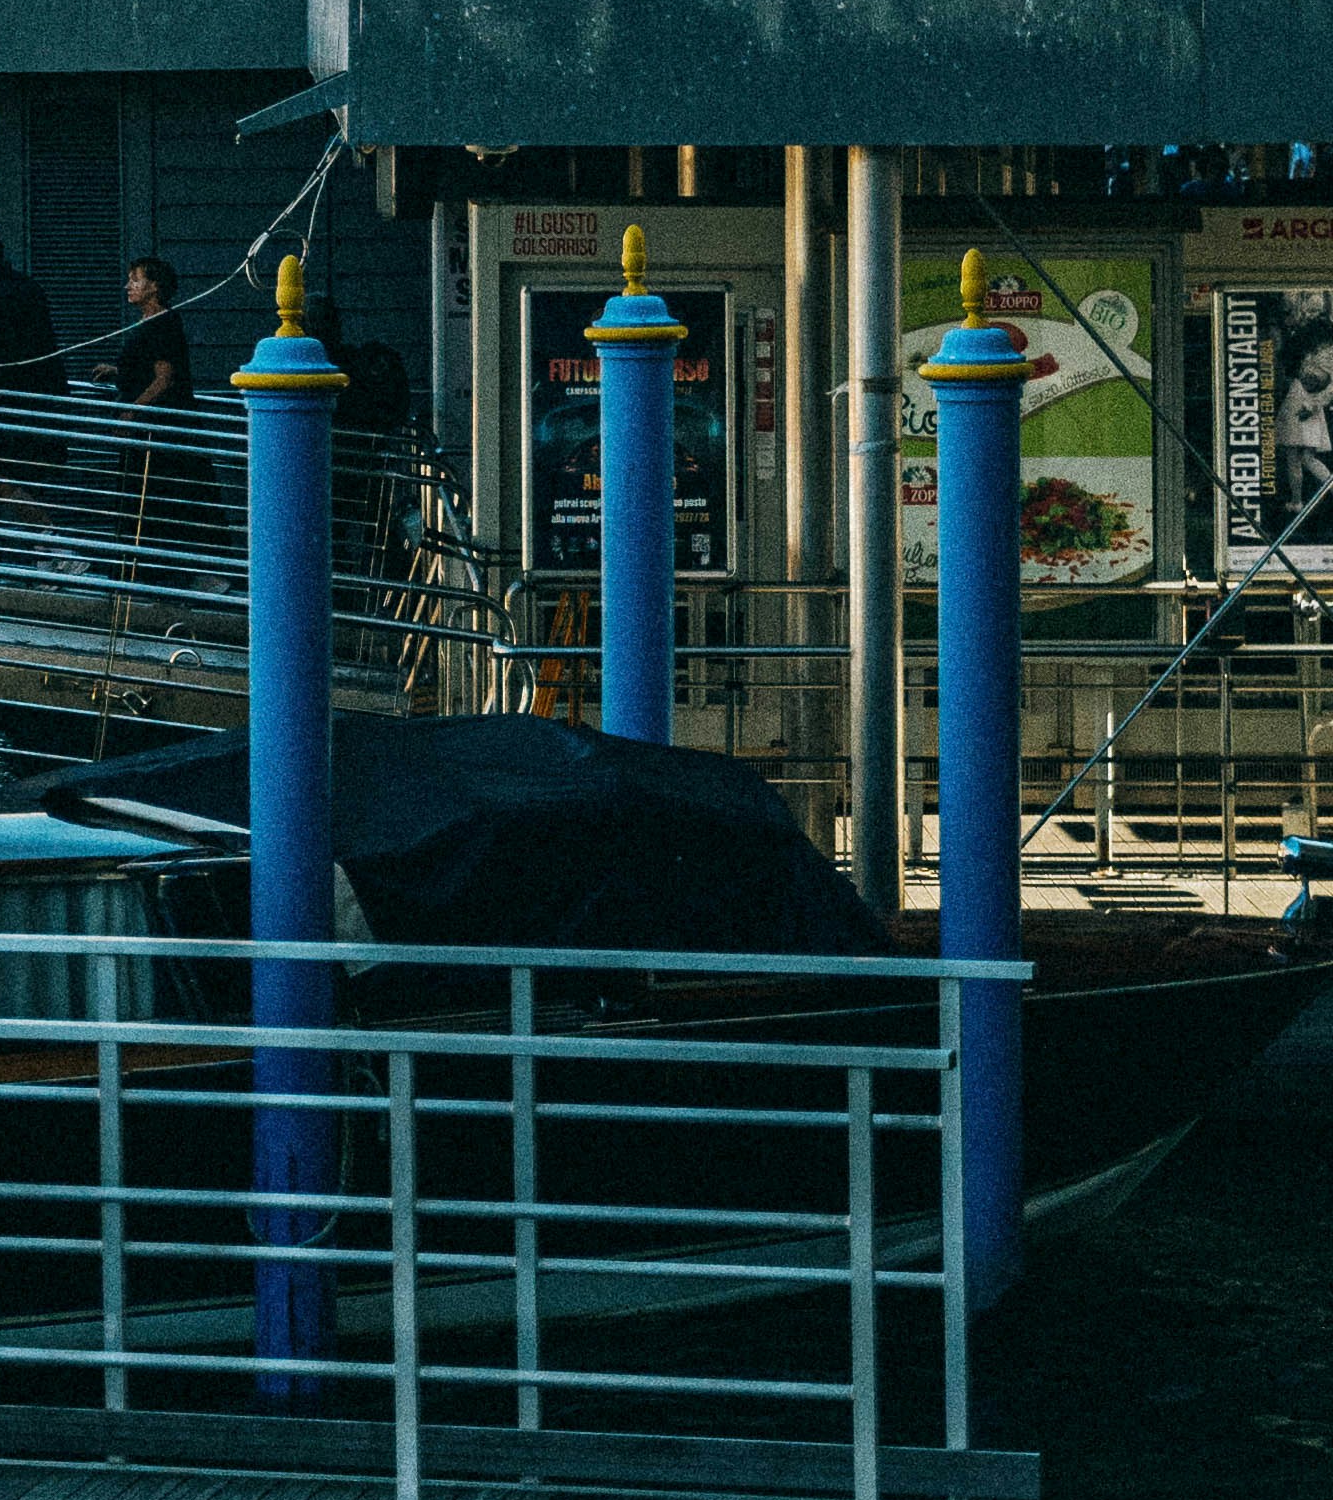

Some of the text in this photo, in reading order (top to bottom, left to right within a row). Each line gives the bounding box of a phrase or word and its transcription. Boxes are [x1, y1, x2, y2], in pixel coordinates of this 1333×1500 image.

[514, 212, 598, 234] #ILGUSTO
[1270, 217, 1333, 239] ARG
[513, 237, 598, 256] COLSORRISO
[999, 295, 1040, 309] ZOPPO
[1088, 301, 1127, 332] BIO
[1226, 295, 1262, 540] ALFRED EISENSTAEDT
